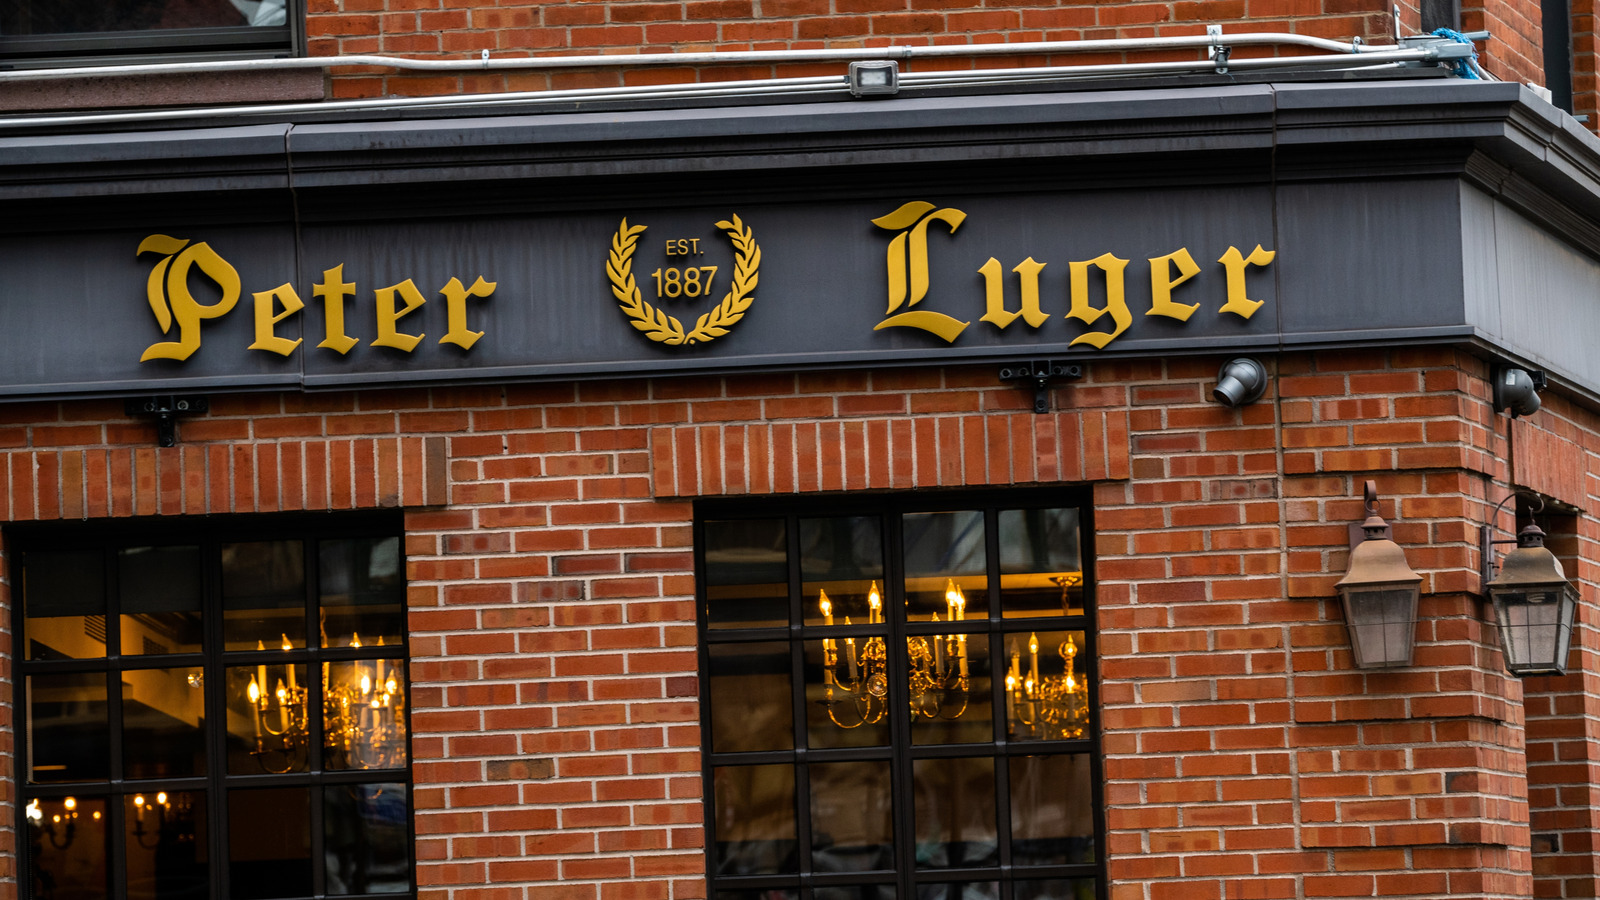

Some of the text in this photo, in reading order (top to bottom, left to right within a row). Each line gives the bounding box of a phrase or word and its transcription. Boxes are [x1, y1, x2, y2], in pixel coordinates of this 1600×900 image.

[665, 238, 704, 256] EST.
[136, 200, 1277, 363] Peter Luger
[651, 265, 719, 298] 1887
